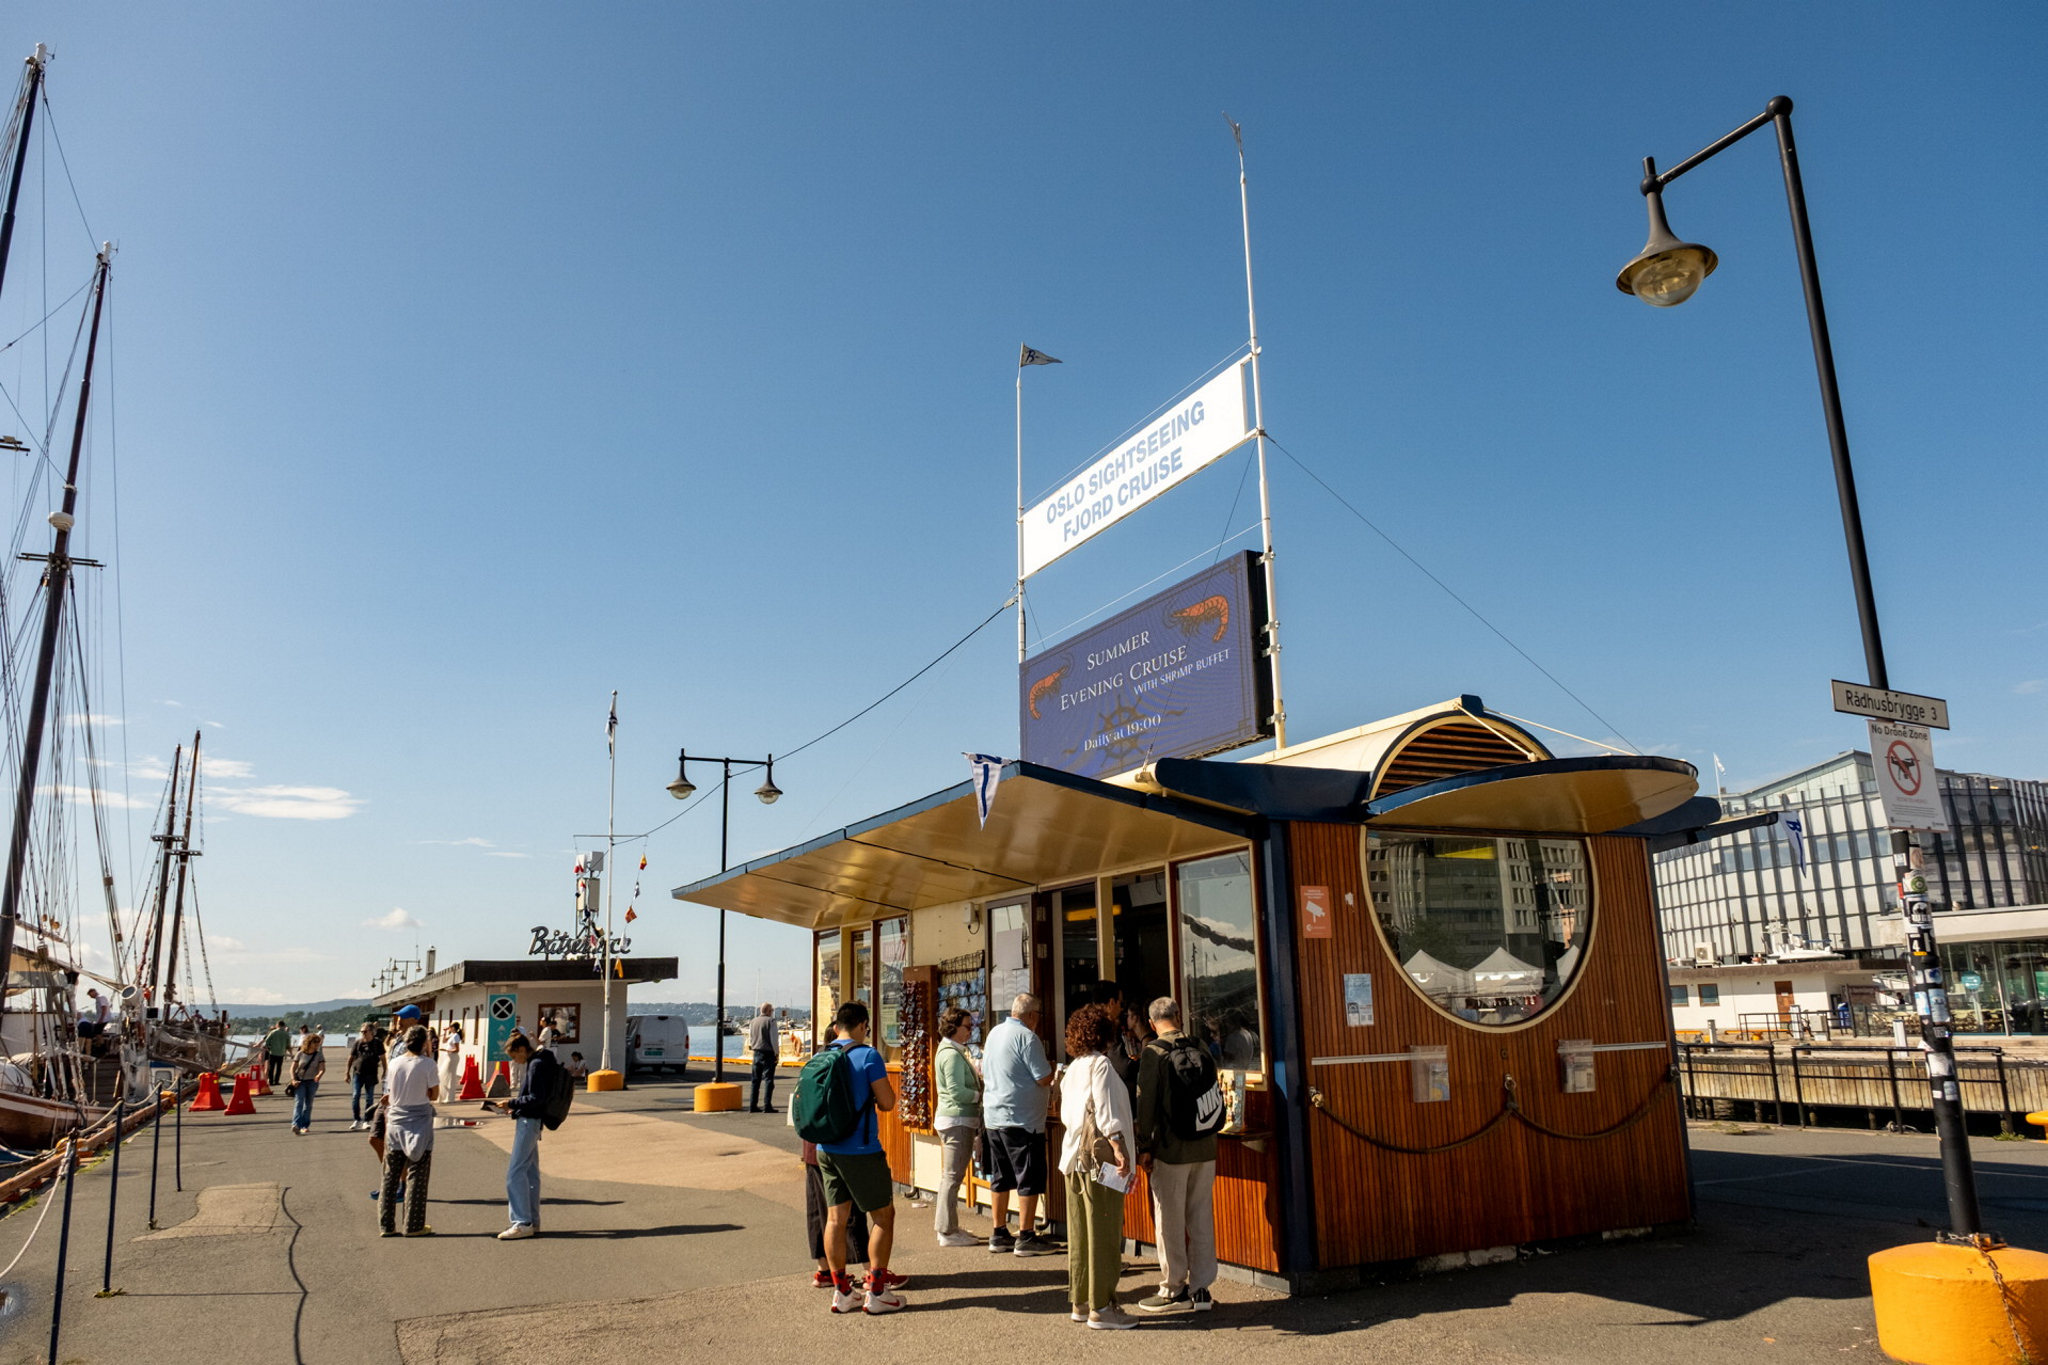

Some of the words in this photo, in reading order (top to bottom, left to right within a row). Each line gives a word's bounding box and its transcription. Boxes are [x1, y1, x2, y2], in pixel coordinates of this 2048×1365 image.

[1046, 483, 1085, 524] OSLO
[1088, 400, 1205, 495] SIGHTSEEING
[1063, 493, 1114, 542] FJORD
[1117, 446, 1183, 506] CRUISE
[1087, 630, 1150, 671] SUMMER
[1133, 677, 1158, 695] WITH
[1160, 663, 1193, 685] SHRIMP
[1196, 647, 1230, 671] BUFFET
[1060, 672, 1124, 711] EVENING
[1129, 645, 1188, 680] CRUISE
[1845, 689, 1925, 721] Rådhusbrygge
[1930, 706, 1938, 721] 3
[1084, 733, 1112, 751] Daily
[1113, 728, 1124, 741] at
[1127, 713, 1161, 736] 19:00
[1871, 723, 1882, 735] No
[1884, 725, 1908, 738] Drone
[1909, 729, 1928, 741] Zone
[528, 925, 632, 955] Båtservce
